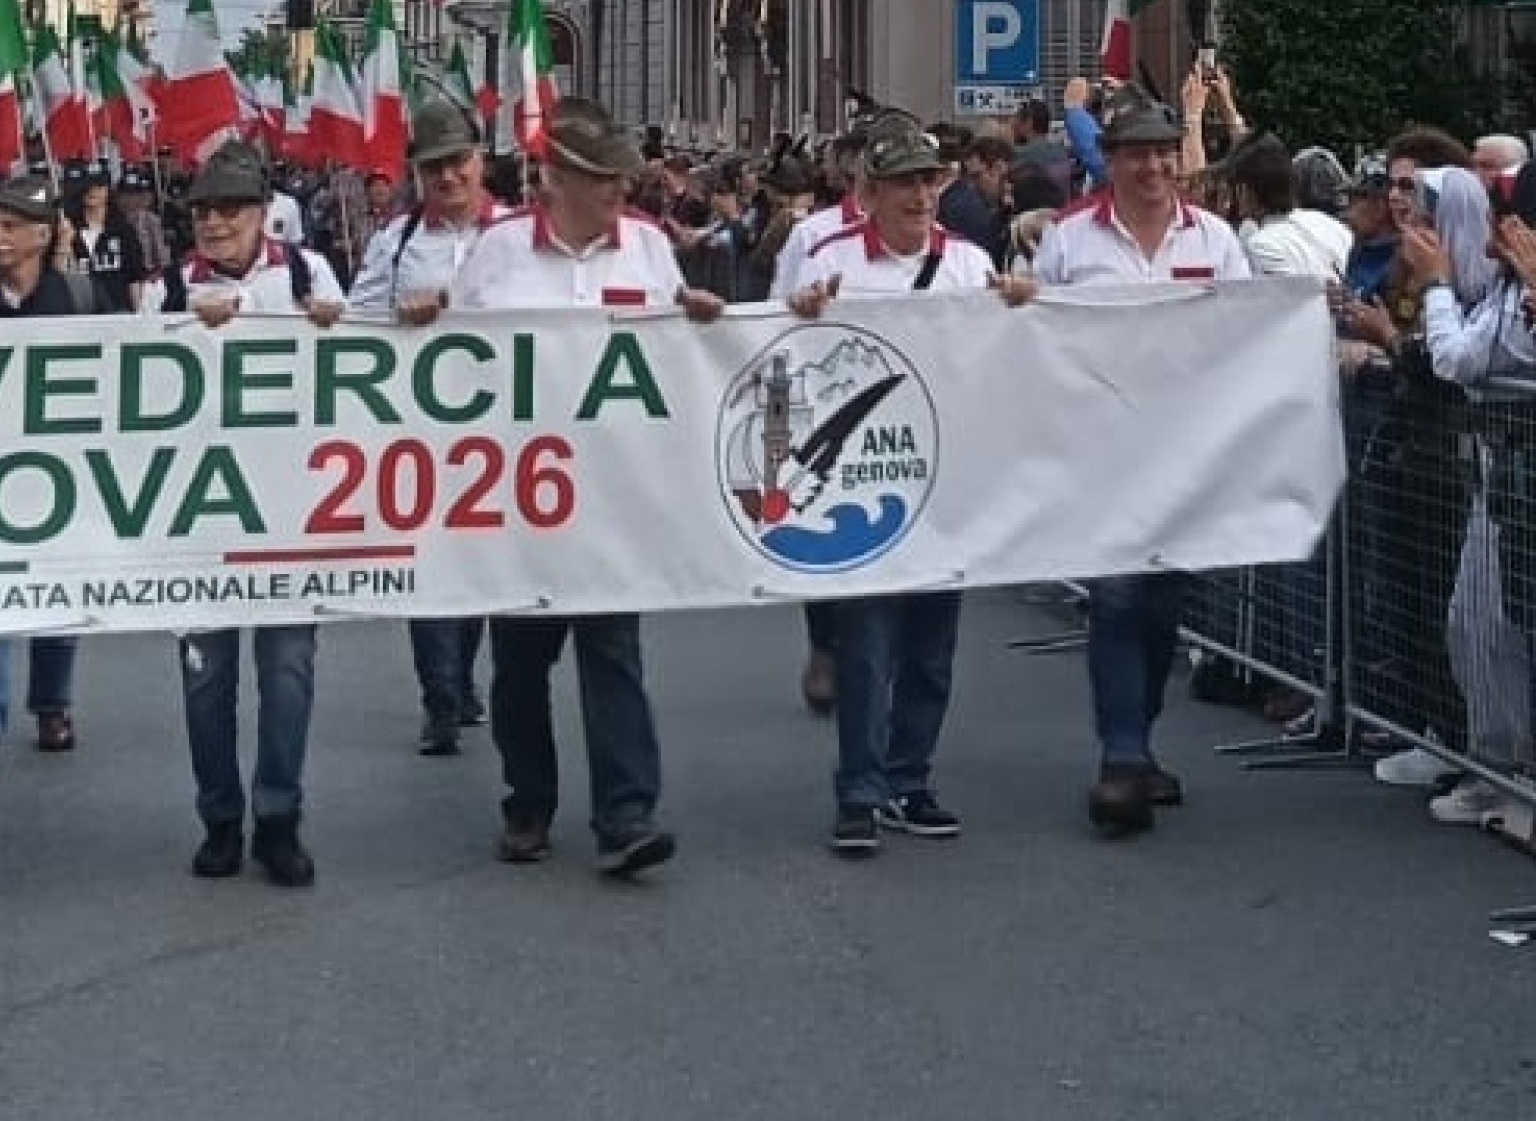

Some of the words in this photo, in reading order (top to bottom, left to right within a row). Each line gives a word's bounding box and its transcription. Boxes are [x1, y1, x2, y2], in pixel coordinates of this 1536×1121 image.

[973, 1, 1021, 74] P
[576, 332, 671, 419] A
[861, 425, 915, 455] ANA
[304, 435, 575, 535] 2026
[841, 457, 927, 490] genova
[82, 574, 291, 608] NAZIONALE
[300, 568, 416, 599] ALPINI
